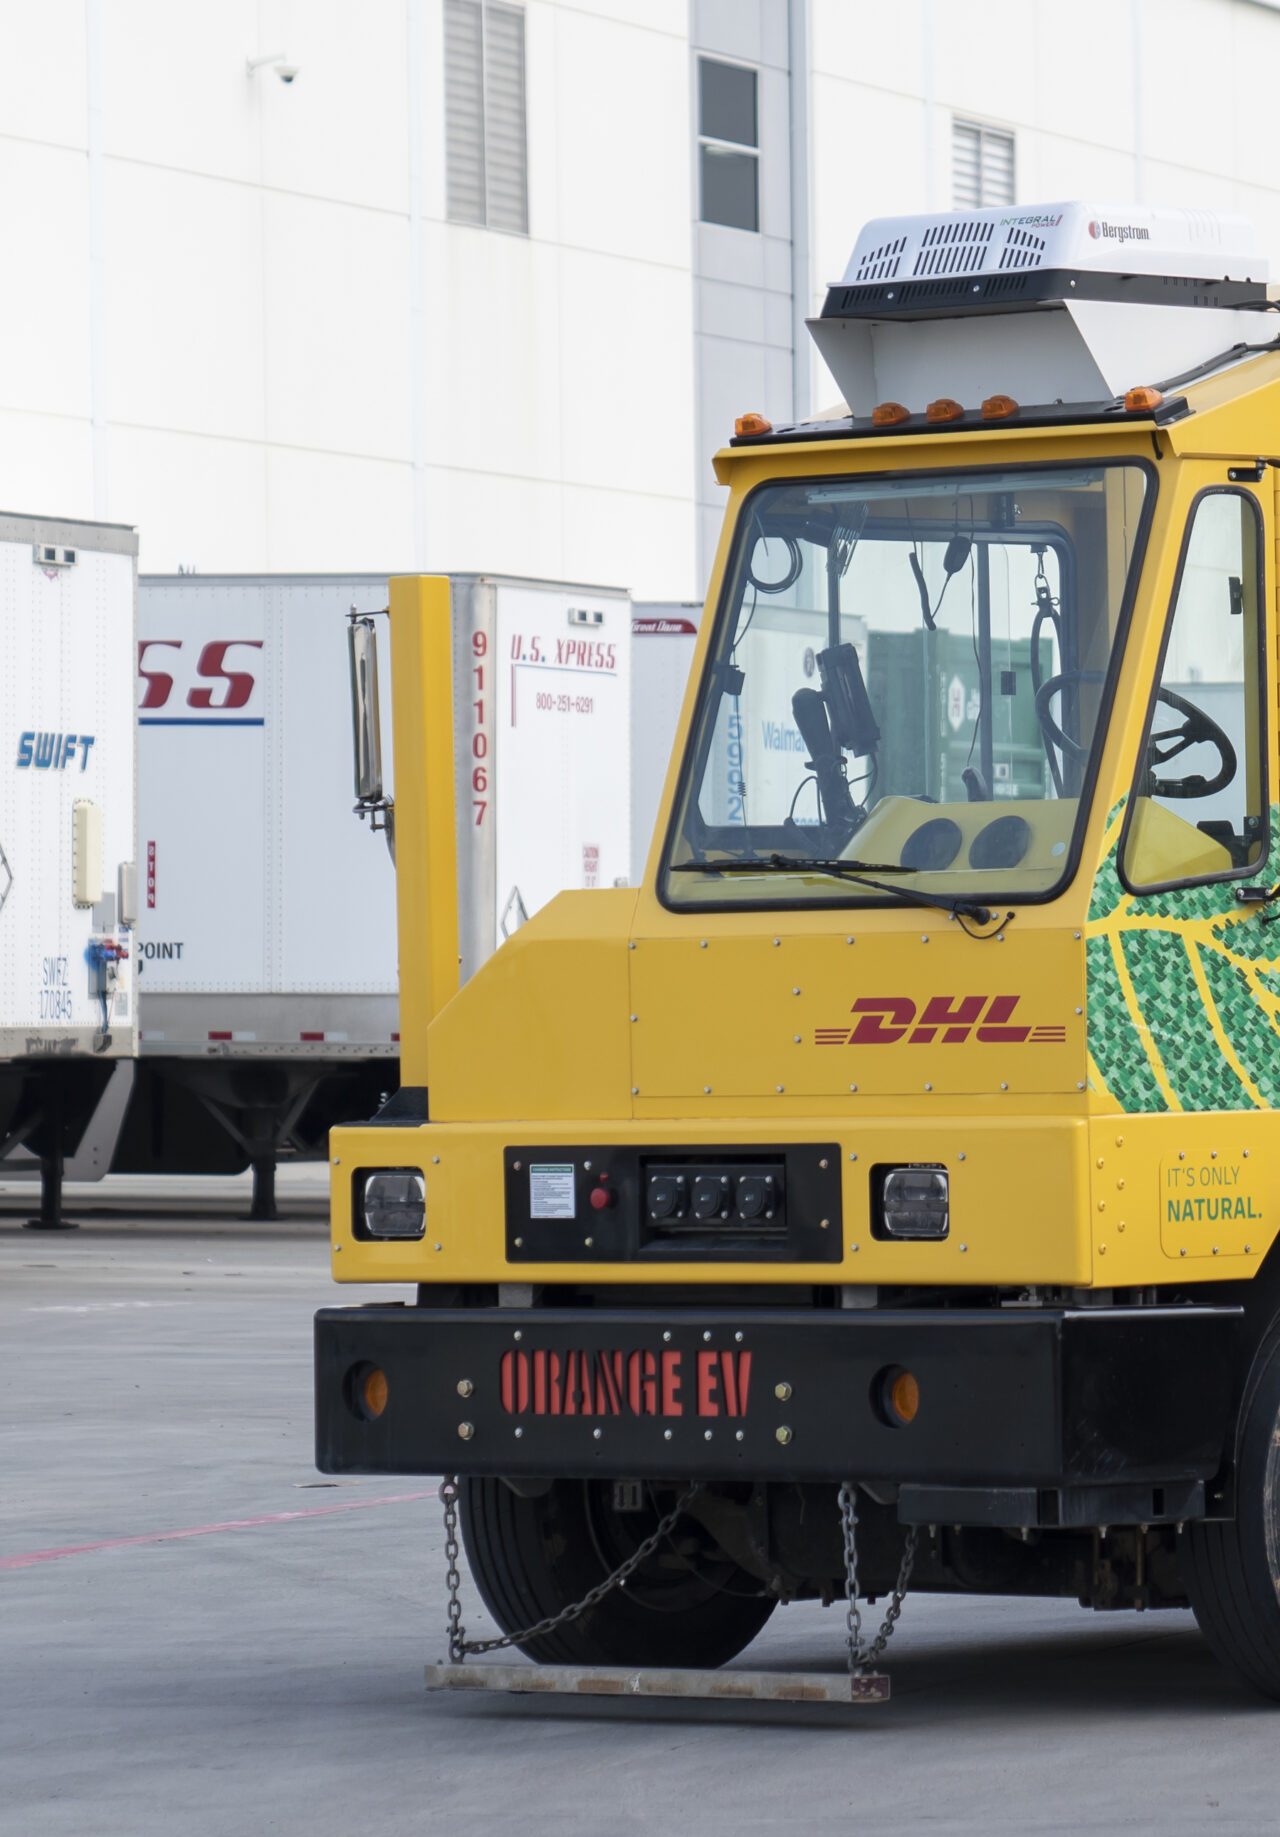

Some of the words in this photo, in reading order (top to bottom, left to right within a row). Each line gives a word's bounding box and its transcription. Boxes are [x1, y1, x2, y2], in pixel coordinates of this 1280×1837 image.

[1000, 214, 1056, 226] INTEGRAL
[1031, 221, 1056, 229] POWER
[1102, 221, 1150, 243] Bergstrom
[656, 619, 683, 632] Dane
[511, 633, 546, 663] U.S.
[554, 637, 617, 670] XPRESS
[535, 692, 594, 714] 800-251-6291
[471, 630, 488, 826] 911067
[761, 719, 806, 752] Walma
[16, 731, 96, 774] SWIFT
[848, 995, 1032, 1045] DHL
[1167, 1167, 1196, 1188] IT'S
[1199, 1165, 1240, 1187] ONLY
[1167, 1196, 1263, 1222] NATURAL.
[500, 1349, 684, 1417] ORANGE
[696, 1350, 753, 1417] EV
